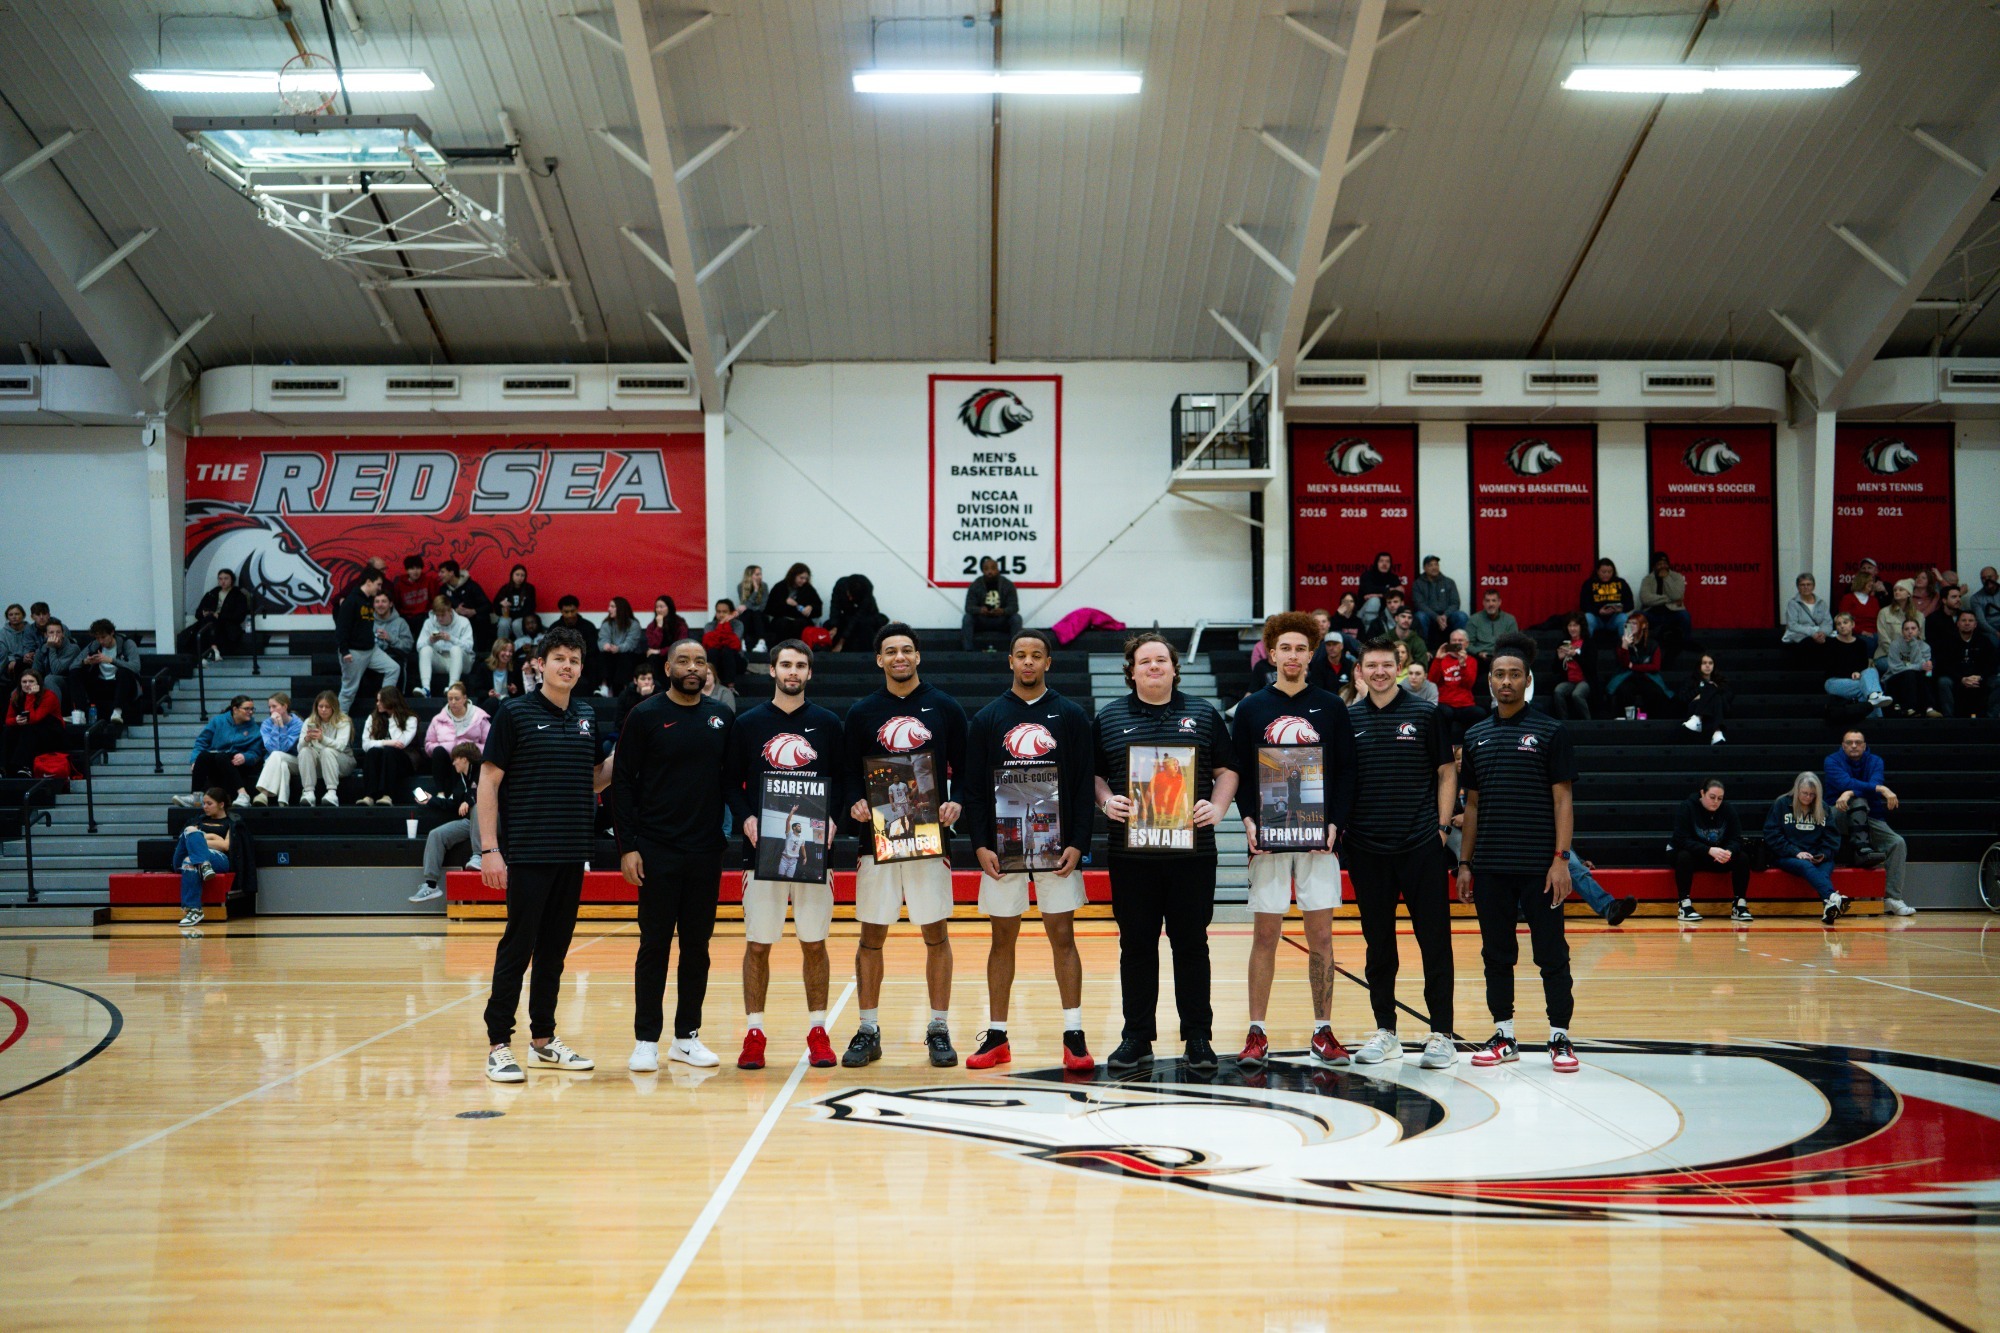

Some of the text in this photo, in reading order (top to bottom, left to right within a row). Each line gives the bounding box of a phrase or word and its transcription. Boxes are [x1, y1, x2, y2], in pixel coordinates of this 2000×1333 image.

[972, 452, 1017, 463] MEN'S
[951, 466, 1039, 476] BASKETBALL
[196, 447, 681, 515] THE RED SEA
[1307, 484, 1402, 493] MEN'S BASKETBALL
[1479, 484, 1589, 493] WOMEN'S BASKETBALL
[1668, 484, 1756, 493] WOMEN'S SOCCER
[1857, 483, 1924, 492] MEN'S TENNIS
[971, 490, 1018, 501] NCCAA
[1296, 496, 1412, 504] CONFERENCE CHAMPIONS
[1656, 496, 1770, 504] CONFERENCE CHAMPIONS
[1893, 495, 1947, 504] CHAMPIONS
[1477, 497, 1591, 505] CONFERENCE CHAMPIONS
[957, 504, 1033, 515] DIVISION II
[1300, 508, 1408, 518] 2016 2018 2023
[1480, 508, 1507, 518] 2013
[1659, 507, 1686, 517] 2012
[1837, 506, 1903, 516] 2019 2021
[961, 517, 1029, 528] NATIONAL
[952, 531, 1037, 541] CHAMPIONS
[1307, 563, 1333, 573] NCAA
[1488, 563, 1581, 573] NCAA TOURNAMENT
[1694, 563, 1760, 572] TOURNAMENT
[1300, 576, 1360, 586] 2016 201
[1481, 576, 1508, 586] 2013
[1700, 576, 1727, 585] 2012
[995, 772, 1057, 785] TISDALE-COUCH
[773, 779, 825, 797] SAREYKA
[1138, 828, 1191, 847] SWARR
[1270, 827, 1323, 841] PRAYLOW
[885, 835, 938, 854] REYNOSO
